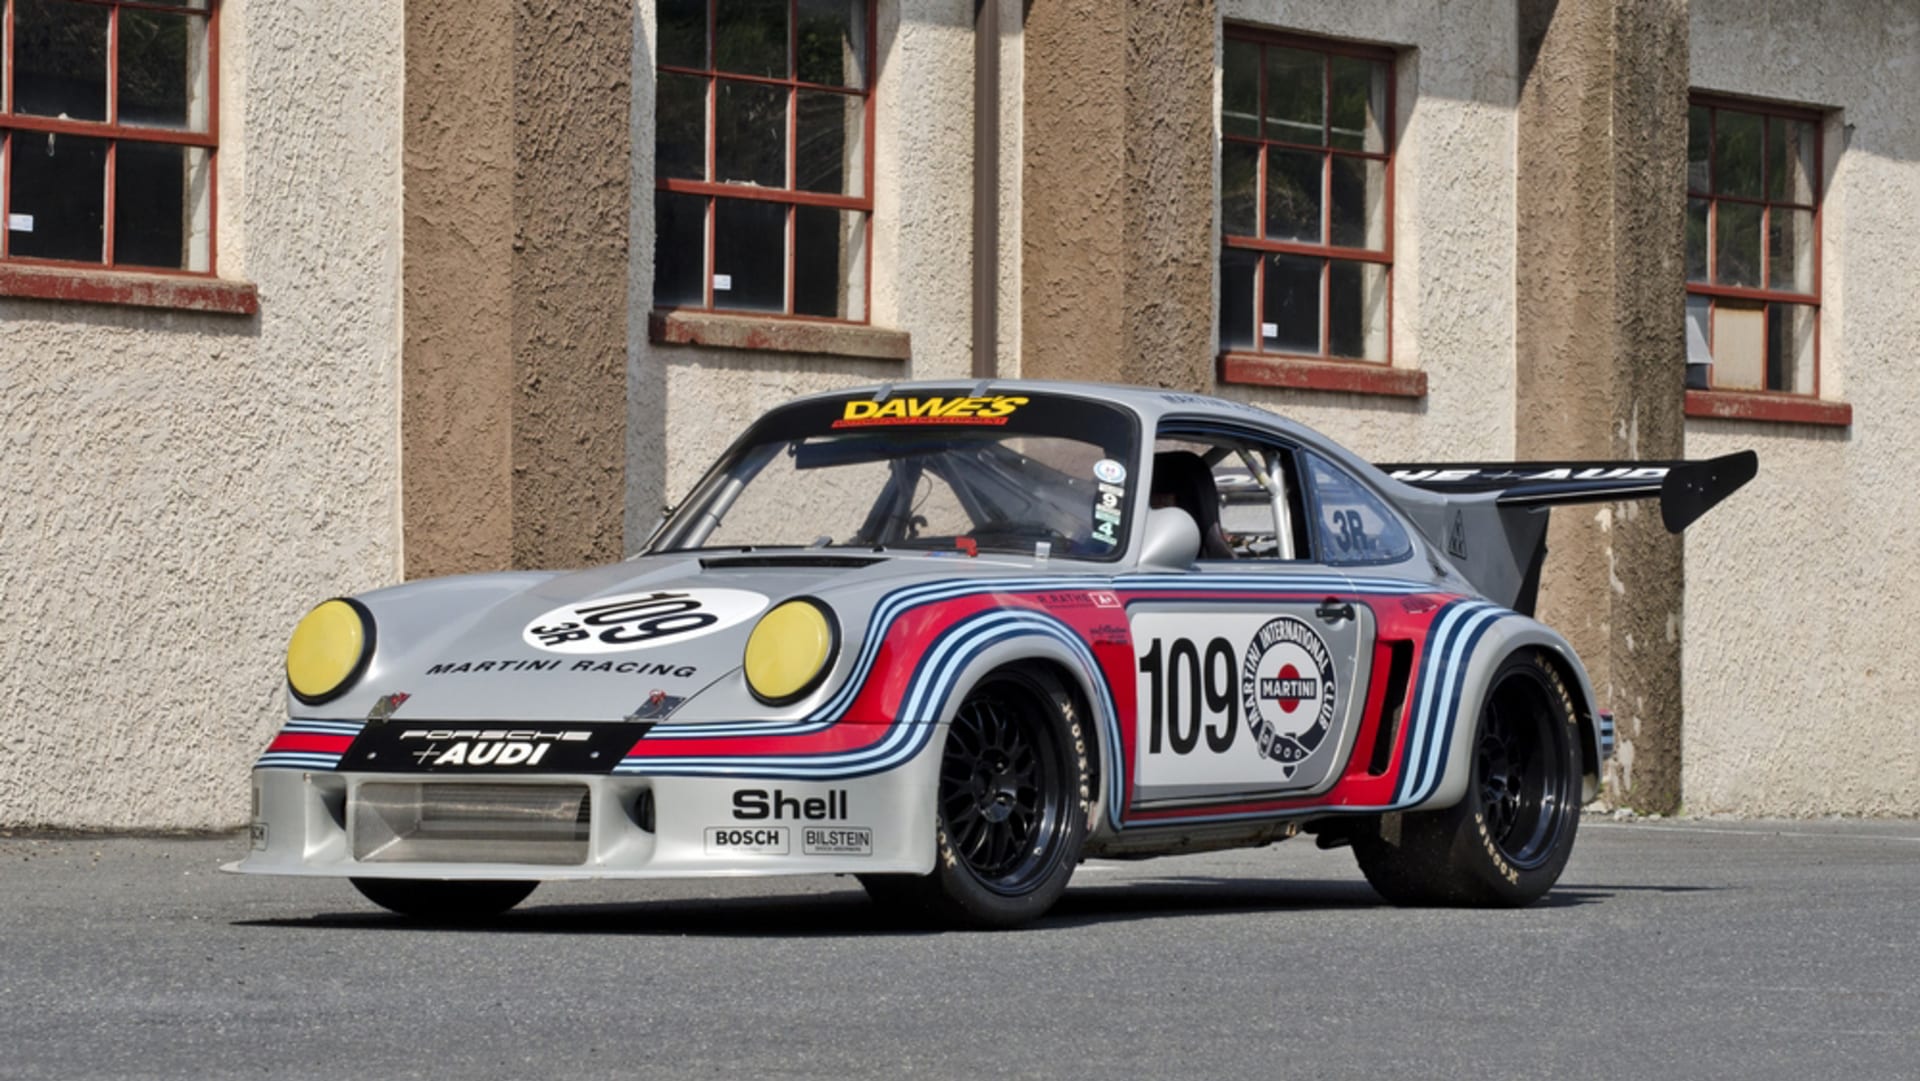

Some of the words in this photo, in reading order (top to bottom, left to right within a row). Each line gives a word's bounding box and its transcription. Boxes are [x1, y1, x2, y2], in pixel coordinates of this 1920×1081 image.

[843, 396, 1030, 421] DAWE'S
[1518, 468, 1671, 480] AUD
[1333, 510, 1370, 553] 3R
[574, 592, 718, 645] 109
[530, 622, 591, 647] 3R
[425, 660, 562, 676] MARTINI
[571, 660, 698, 679] RACING
[1244, 641, 1262, 728] MARTINI
[1259, 619, 1330, 675] INTERNATIONAL
[1317, 680, 1336, 731] CLUB
[1139, 636, 1240, 756] 109
[1262, 680, 1316, 698] MARTINI
[400, 730, 593, 742] PORSCHE
[732, 789, 848, 820] Shell
[715, 830, 780, 846] BOSCH
[806, 831, 870, 847] BILSTEIN
